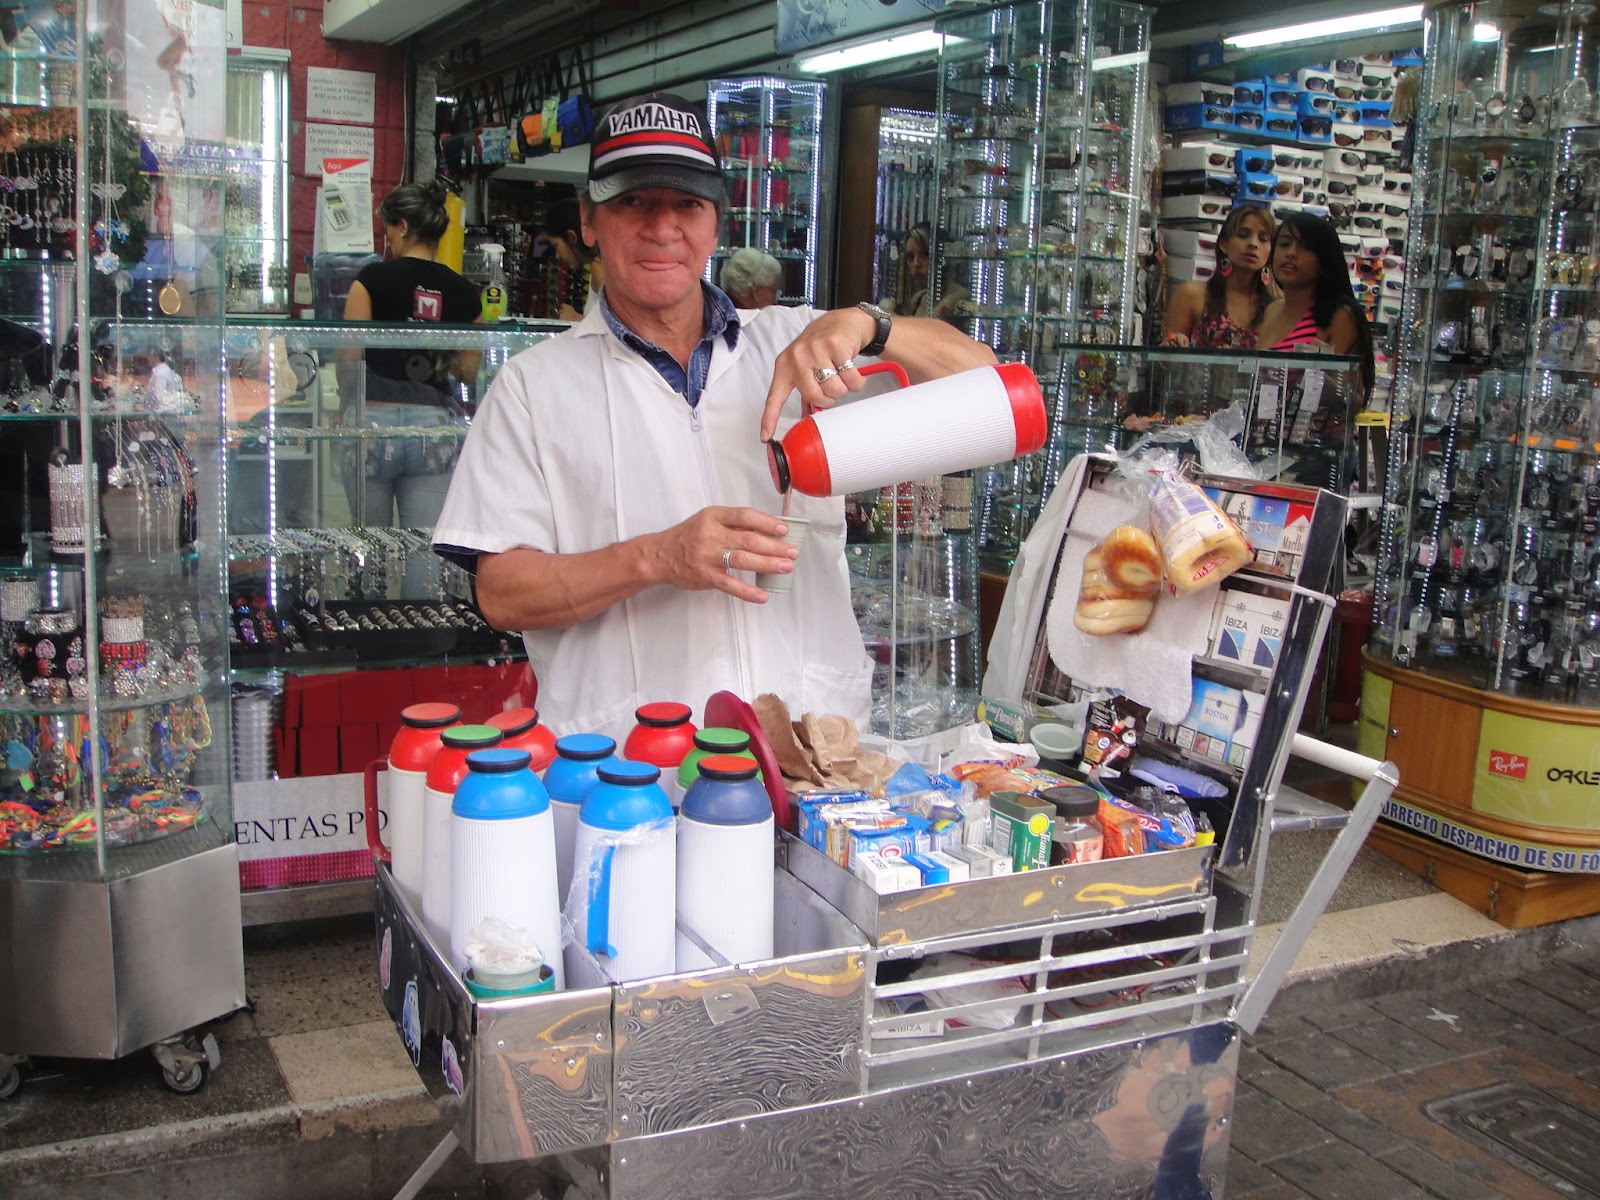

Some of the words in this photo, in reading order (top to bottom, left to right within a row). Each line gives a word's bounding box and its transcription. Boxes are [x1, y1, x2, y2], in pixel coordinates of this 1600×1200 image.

[609, 102, 702, 139] YAMAHA
[1225, 615, 1248, 631] IBIZA
[1205, 707, 1230, 721] BOSTON
[1491, 755, 1526, 773] Ray-Ban
[1441, 823, 1520, 861] DESPACHO
[1525, 847, 1547, 866] DE
[1552, 852, 1576, 870] SU
[896, 1023, 922, 1033] IBIZA
